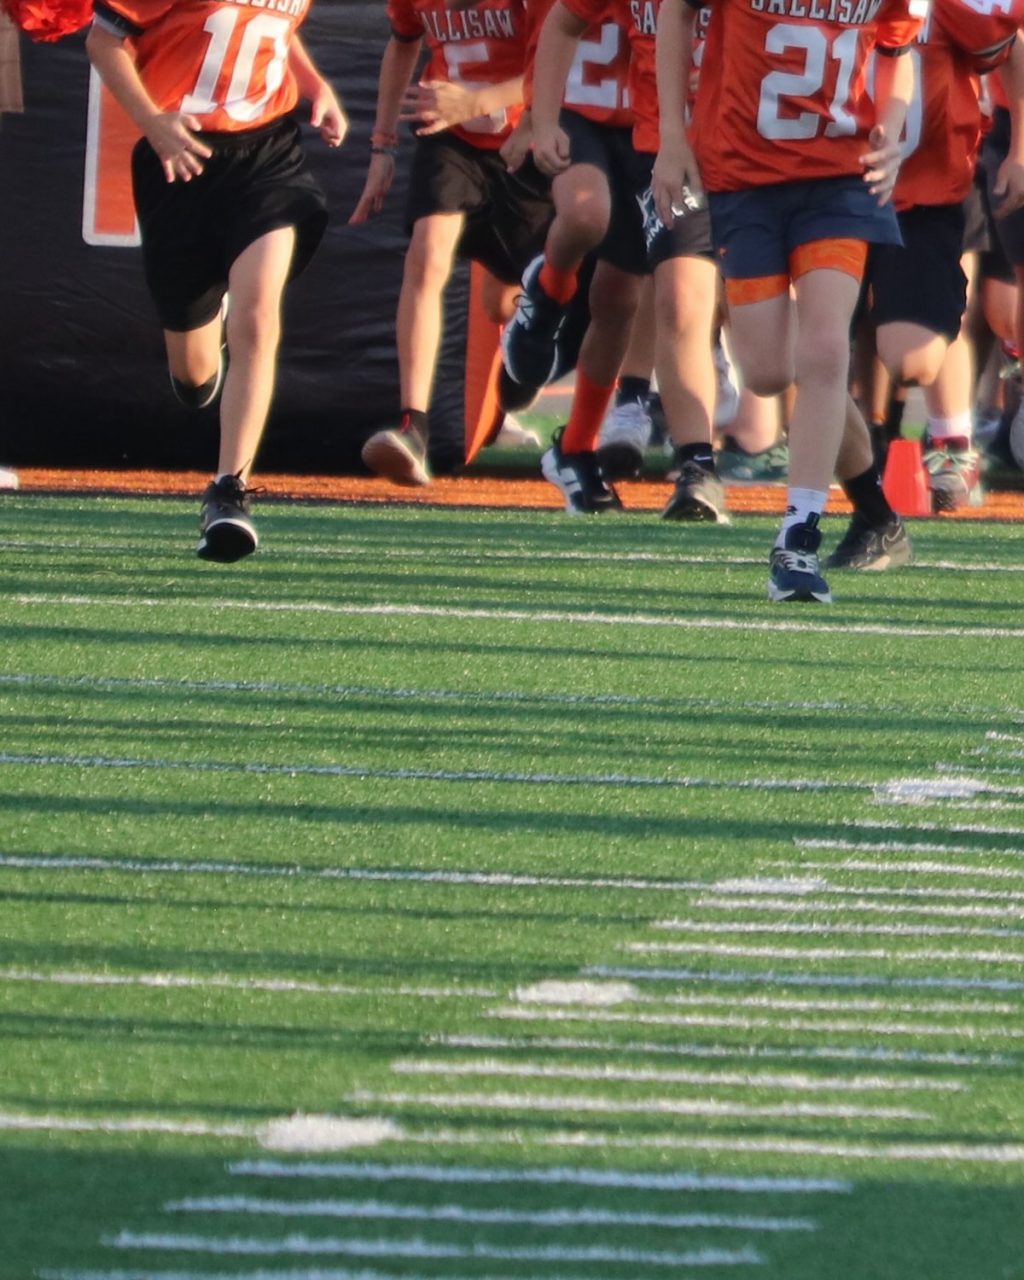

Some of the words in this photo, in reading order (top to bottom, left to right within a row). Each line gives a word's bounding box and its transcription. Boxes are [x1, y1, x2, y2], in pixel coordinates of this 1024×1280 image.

[179, 5, 292, 122] 10
[416, 8, 515, 42] LLISAW
[563, 22, 631, 110] 2
[756, 23, 858, 141] 21
